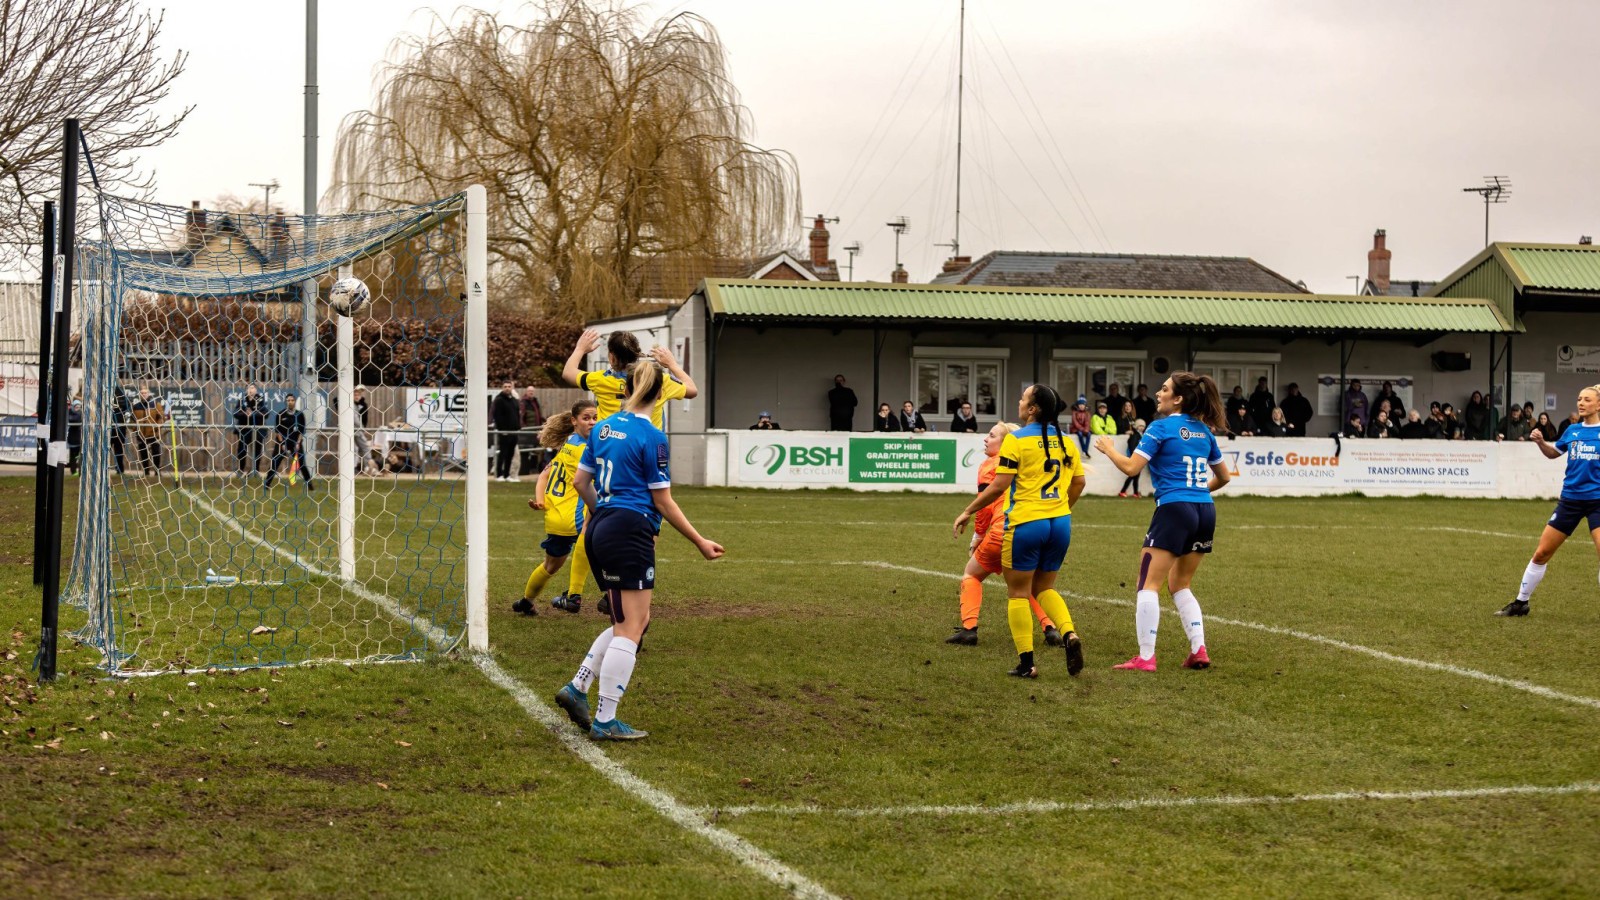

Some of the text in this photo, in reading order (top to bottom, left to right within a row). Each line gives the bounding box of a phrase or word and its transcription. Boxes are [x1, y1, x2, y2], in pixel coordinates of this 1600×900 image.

[904, 443, 922, 451] HIRE
[1576, 444, 1596, 453] Urban
[789, 446, 843, 466] BSH
[866, 452, 920, 460] GRAB/TIPPER
[875, 461, 930, 470] WHEELIE BINS
[889, 471, 945, 479] MANAGEMENT
[1250, 469, 1335, 478] GLASS AND GLAZING
[1367, 466, 1470, 476] TRANSFORMING SPACES
[545, 461, 567, 498] 18
[1041, 459, 1061, 499] 2
